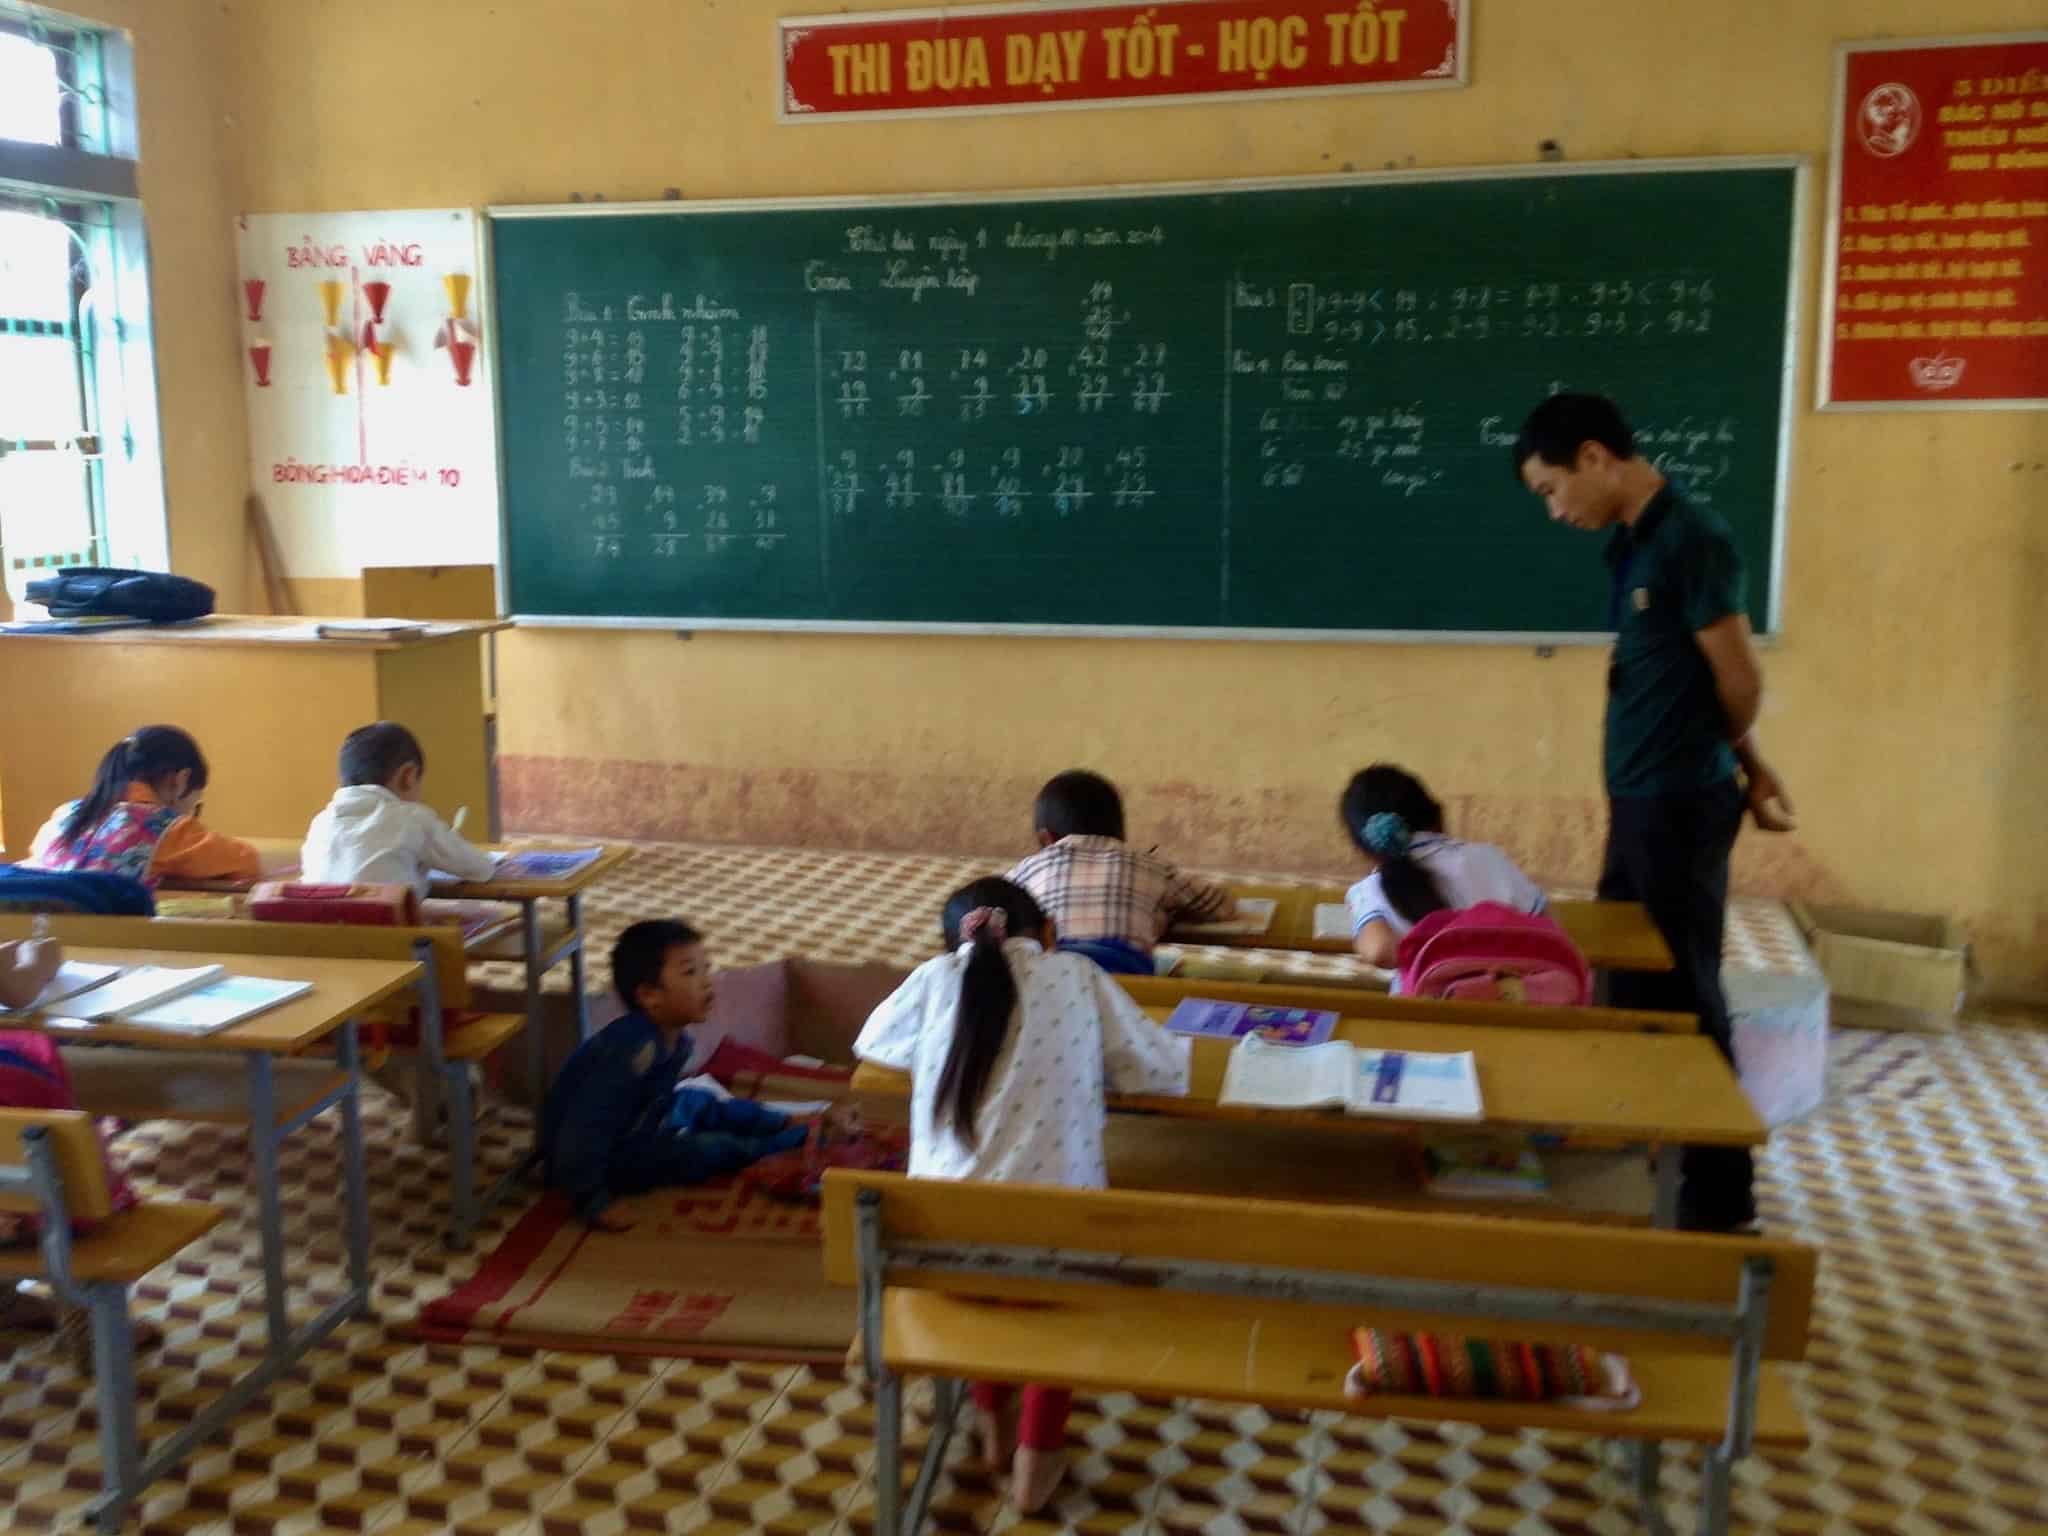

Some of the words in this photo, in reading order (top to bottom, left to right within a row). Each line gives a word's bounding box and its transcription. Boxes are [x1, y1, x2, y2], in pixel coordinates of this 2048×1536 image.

[828, 44, 890, 95] THI
[905, 38, 990, 92] ĐUA
[1006, 30, 1084, 93] DẠY
[1103, 8, 1179, 79] TỐT
[1219, 18, 1307, 81] HỌC
[1325, 2, 1406, 66] TỐT
[286, 234, 348, 268] BẢNG
[363, 238, 424, 268] VÀNG
[272, 457, 326, 484] BÔNG
[439, 468, 461, 488] 10
